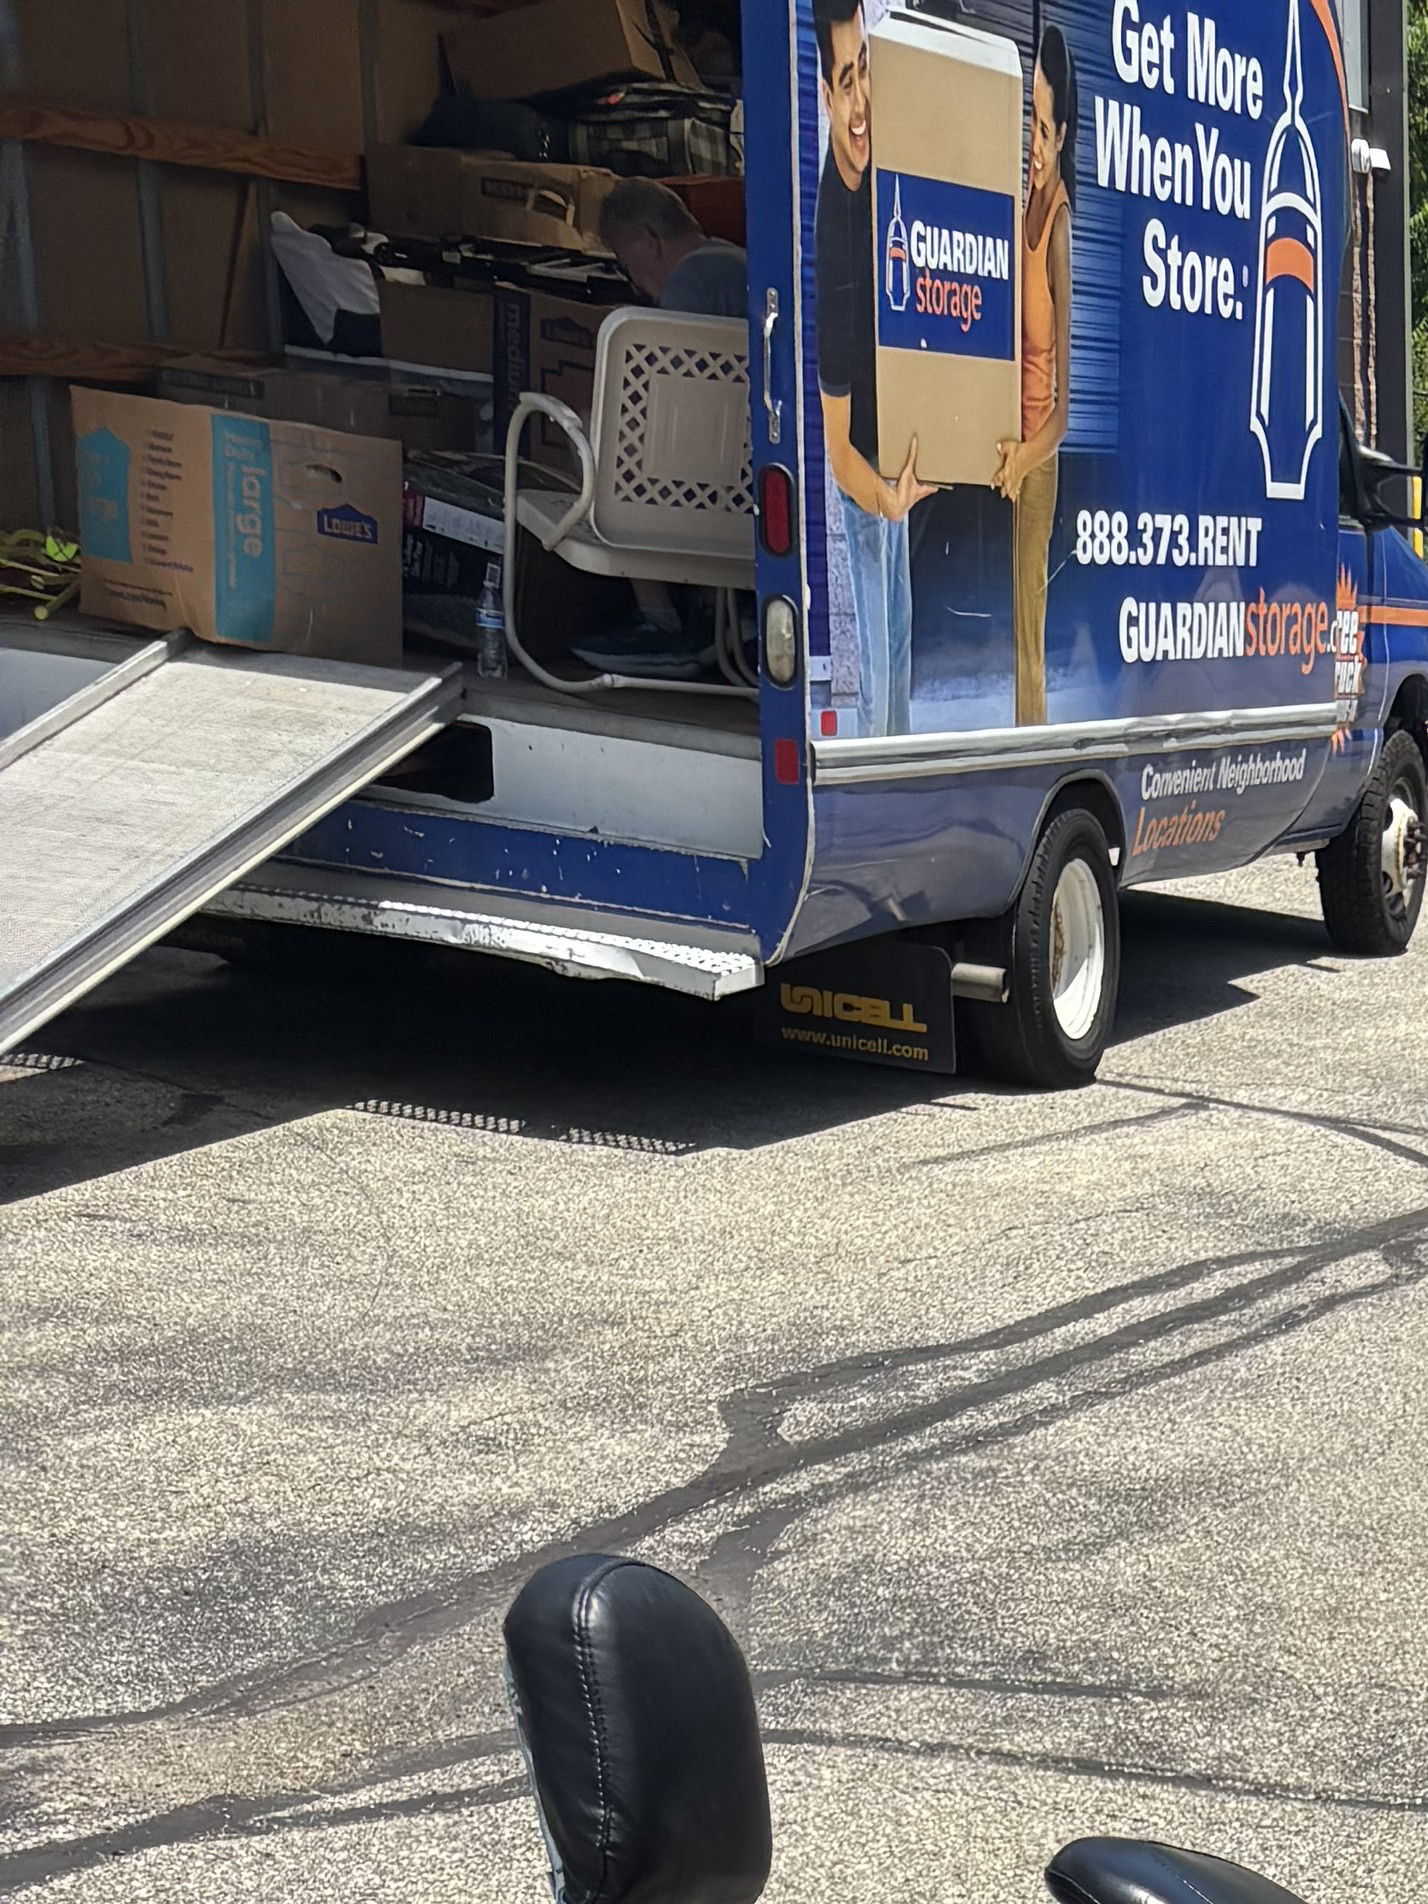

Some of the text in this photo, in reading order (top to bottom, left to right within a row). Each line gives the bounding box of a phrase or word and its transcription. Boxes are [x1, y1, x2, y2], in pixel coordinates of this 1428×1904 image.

[1112, 0, 1263, 120] Get More
[1094, 95, 1251, 220] When You
[910, 220, 1009, 280] GUARDIAN
[915, 268, 983, 333] storage
[236, 465, 267, 557] large
[1076, 509, 1263, 567] 888.373.RENT
[1141, 748, 1307, 801] Convenient Neighborhood
[1132, 800, 1226, 857] Locations
[780, 982, 928, 1033] UNICELL
[780, 1027, 929, 1061] www.unicell.com
